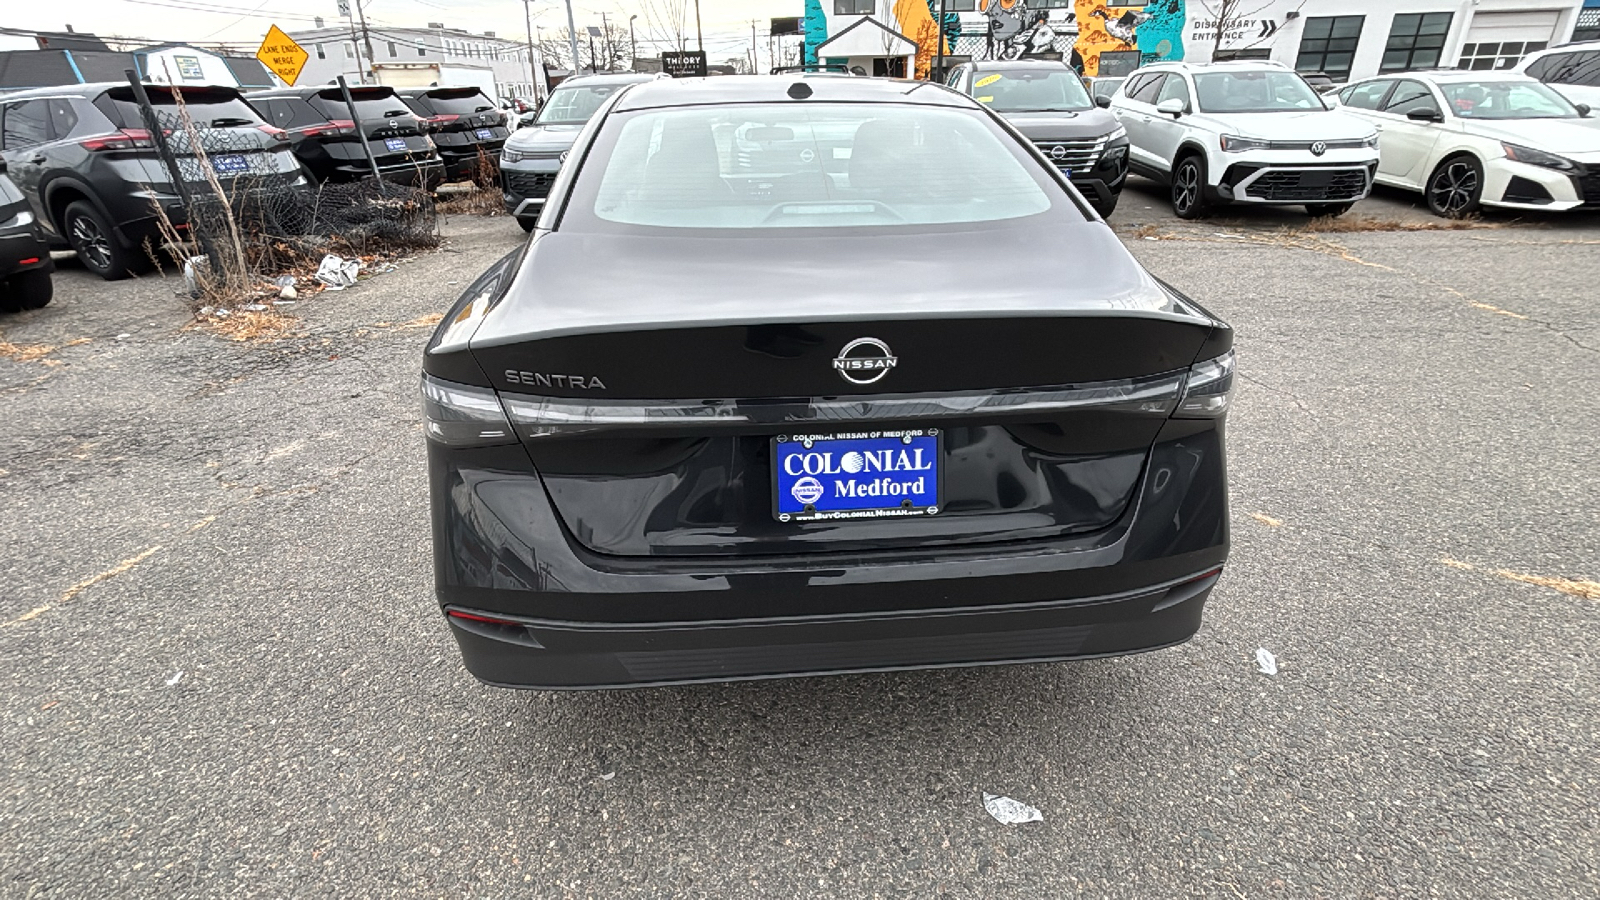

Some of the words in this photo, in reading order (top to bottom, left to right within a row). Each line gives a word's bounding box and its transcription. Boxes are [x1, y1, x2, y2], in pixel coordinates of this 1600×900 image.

[1194, 20, 1256, 29] DISPNSARY
[1192, 32, 1243, 40] ENTRNCE
[263, 45, 280, 53] LANE
[281, 45, 298, 53] ENDS
[273, 57, 295, 65] MERGE
[833, 359, 897, 369] NISSAN
[504, 369, 607, 390] SENTRA
[792, 433, 836, 442] COLONIAL
[836, 432, 868, 440] NISSAN
[870, 431, 882, 439] OF
[883, 429, 923, 438] MEDFORD
[784, 448, 932, 476] COLONIAL
[834, 476, 926, 498] Medford
